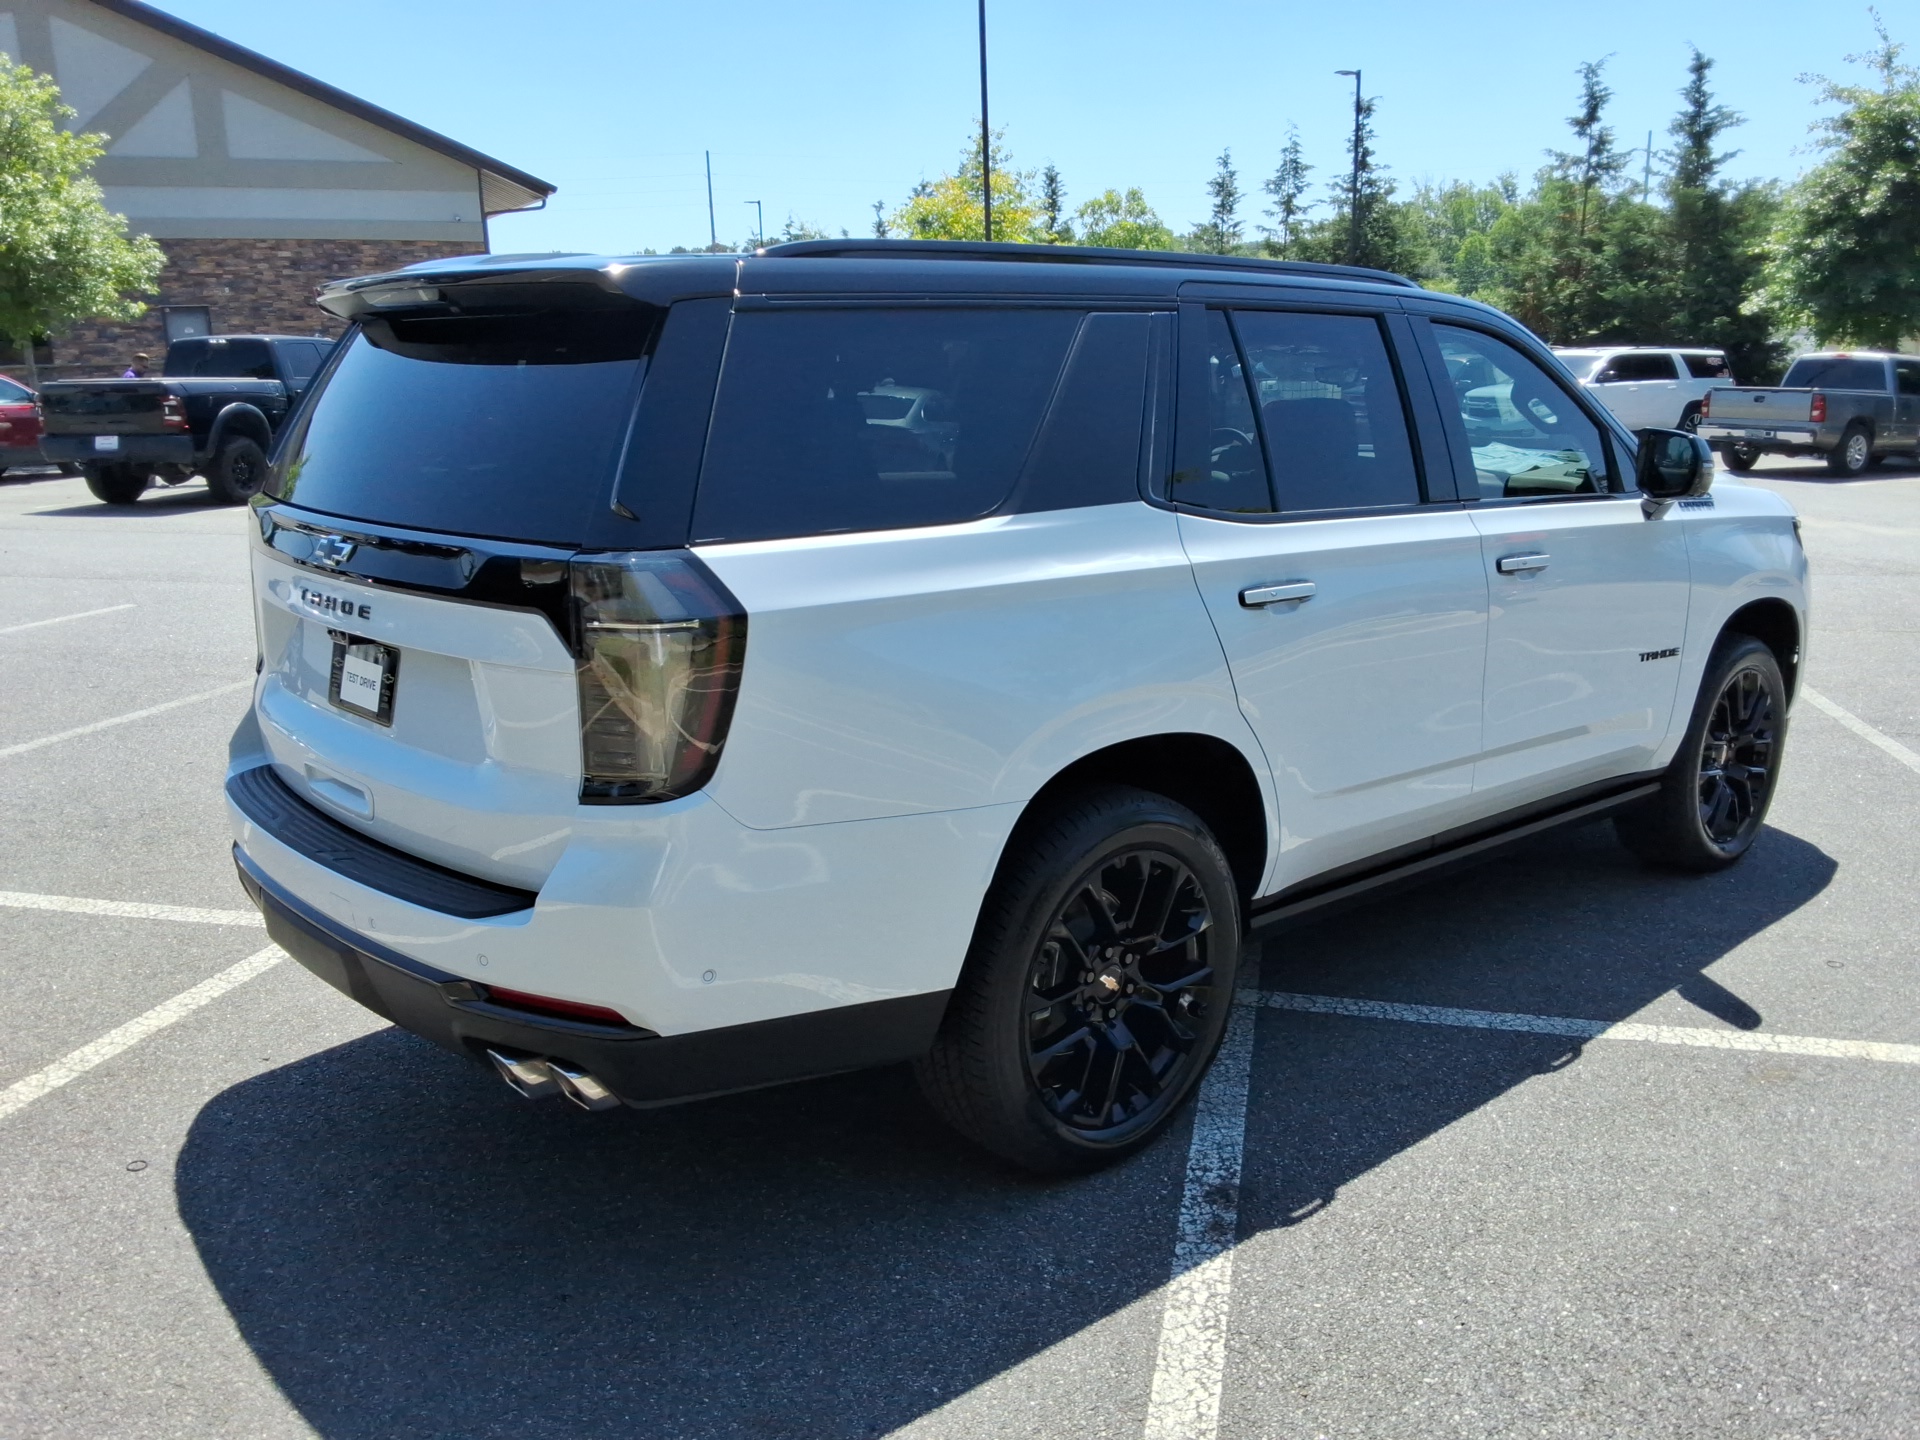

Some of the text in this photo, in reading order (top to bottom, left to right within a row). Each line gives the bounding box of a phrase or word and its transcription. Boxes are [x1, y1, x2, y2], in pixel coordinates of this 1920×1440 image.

[301, 588, 371, 620] TAHOE
[1639, 647, 1680, 662] TAHOE
[347, 671, 359, 684] TEST
[359, 676, 377, 691] DRIVE
